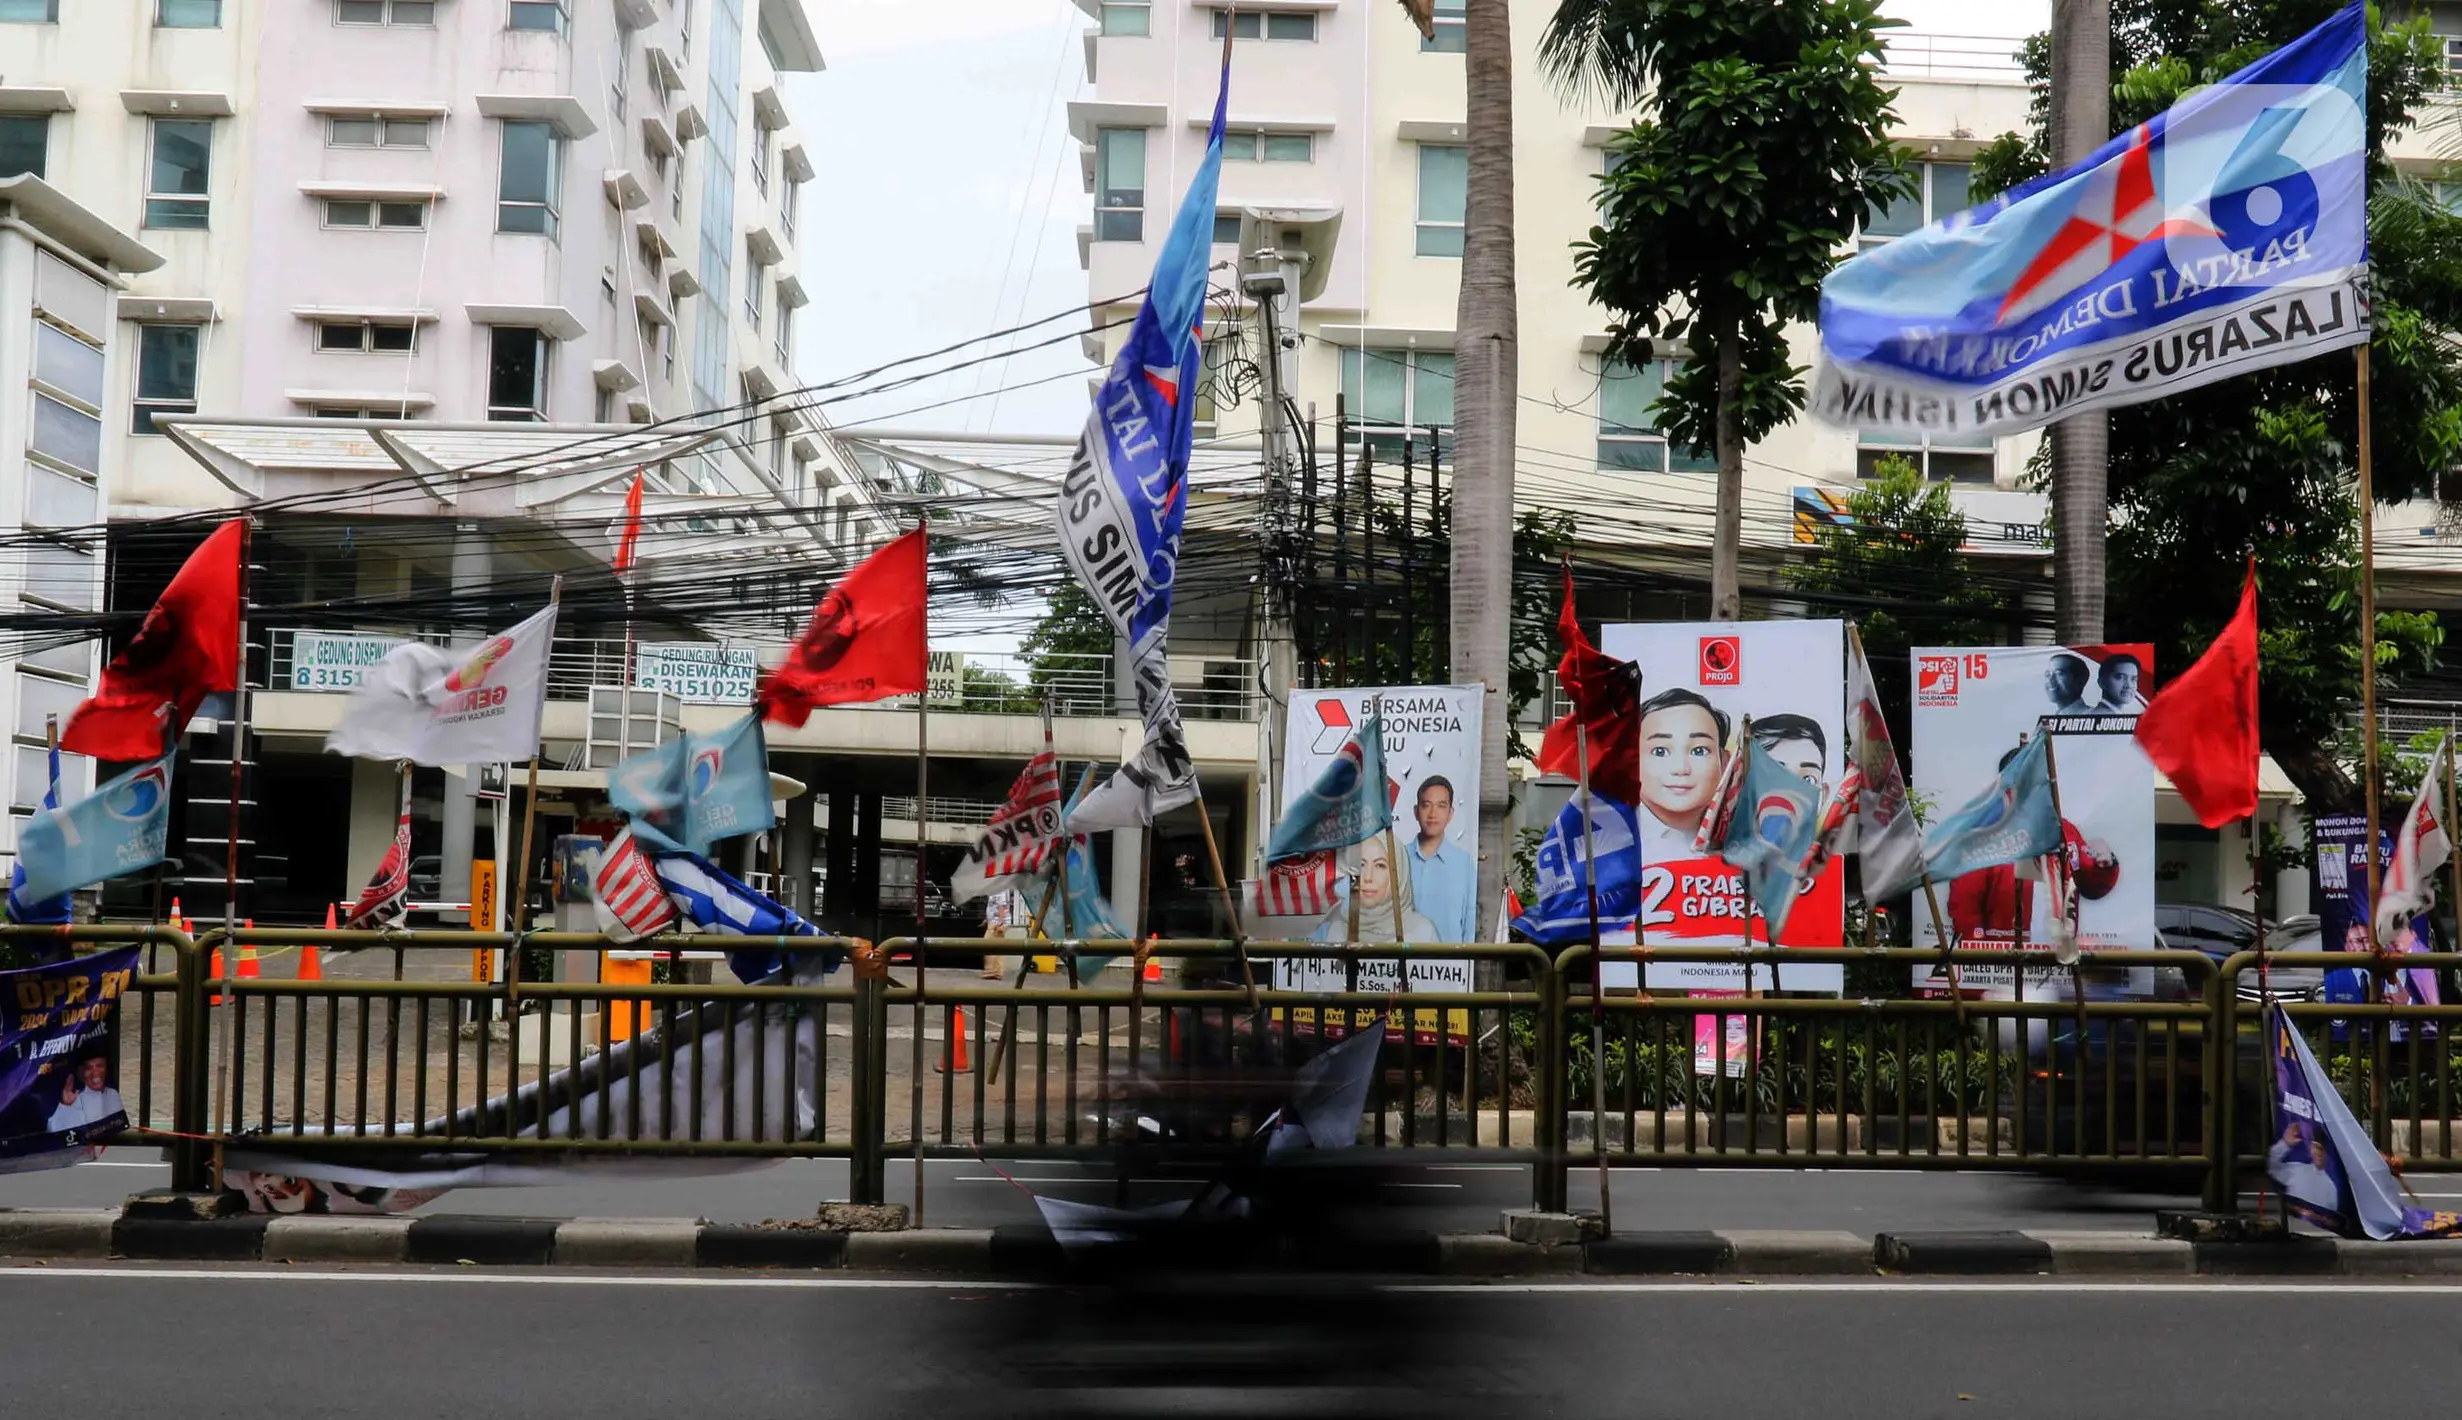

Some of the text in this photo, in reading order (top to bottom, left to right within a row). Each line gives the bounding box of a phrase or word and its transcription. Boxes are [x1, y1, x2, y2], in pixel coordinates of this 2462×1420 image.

[317, 640, 353, 665] GEDUNG
[661, 663, 752, 679] DISEWAKAN
[1919, 654, 1988, 680] PSI 15
[1705, 672, 1734, 683] PROJO
[661, 678, 750, 698] 3151025
[1360, 697, 1447, 715] BRSAMA
[2058, 717, 2096, 732] PARTAI
[2096, 717, 2138, 731] JOKOWI
[1641, 865, 1676, 926] 2
[1409, 963, 1467, 985] ALIYAH,
[1680, 968, 1731, 977] INDONESIA
[1962, 975, 1992, 985] JAKARTA
[1992, 976, 2014, 986] PUSAT
[17, 967, 131, 1010] DPR RI
